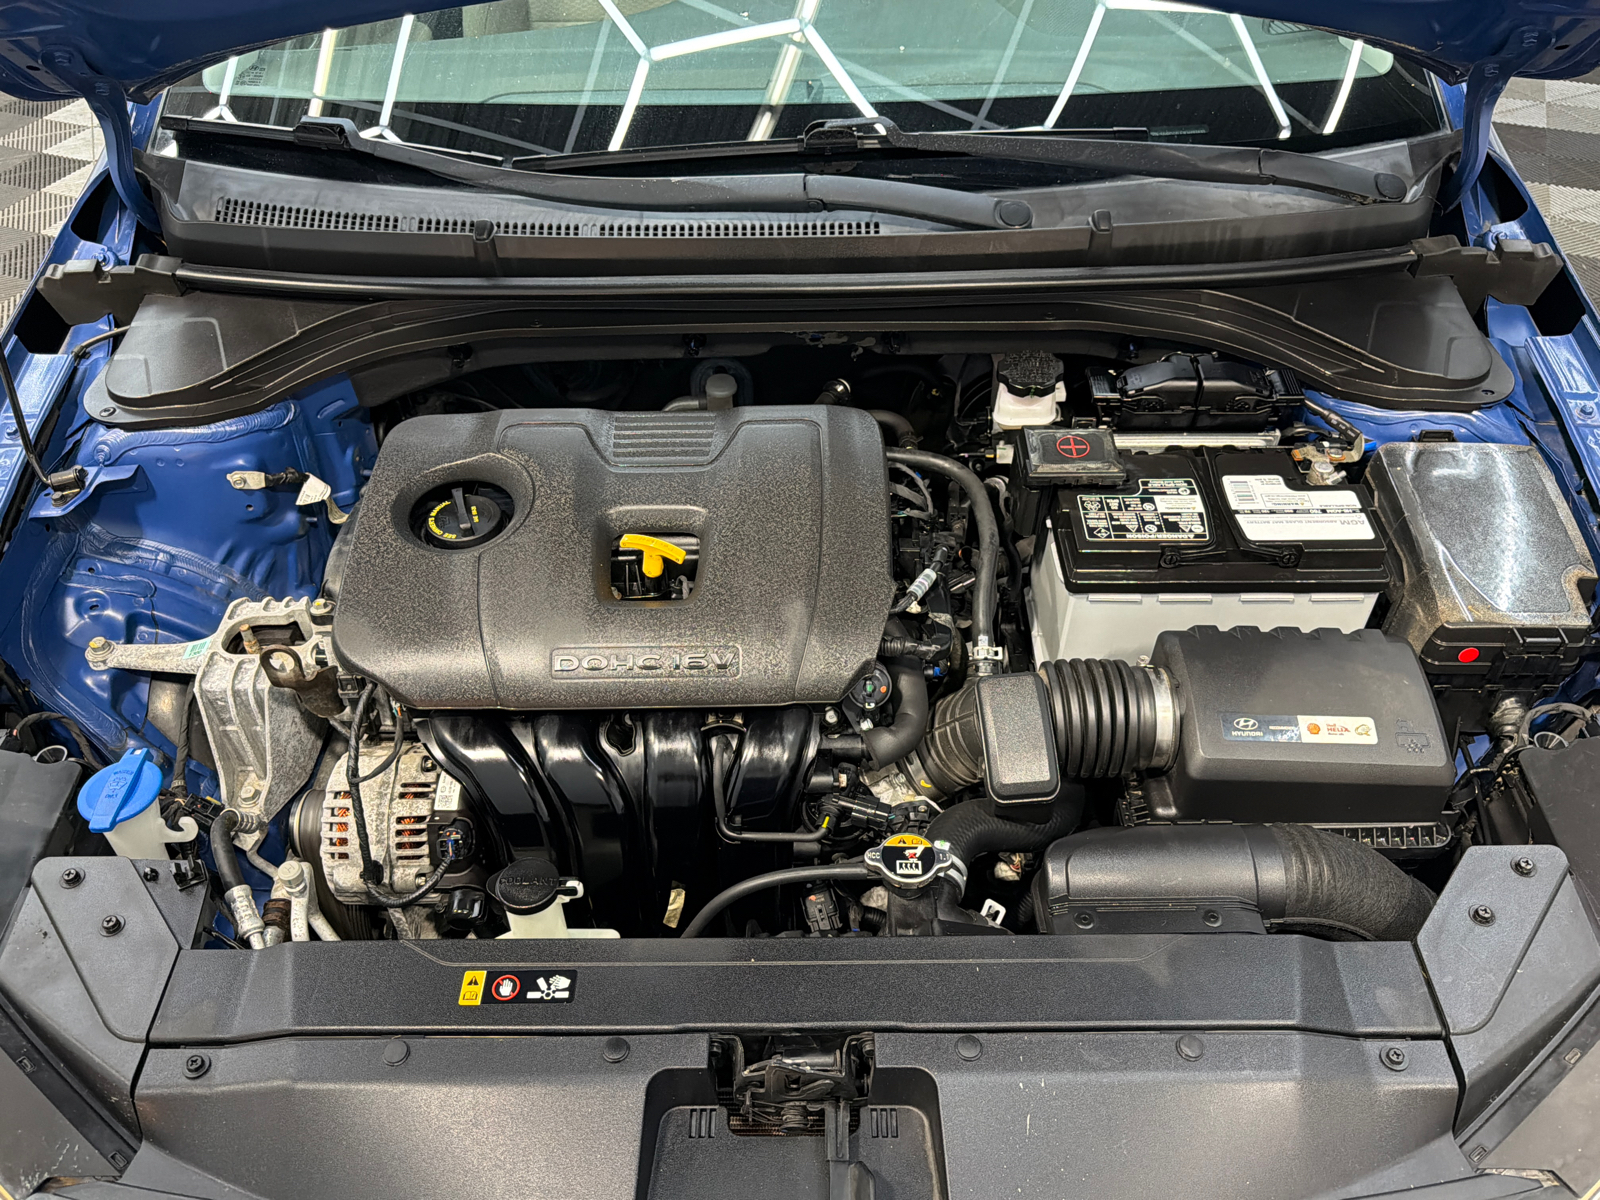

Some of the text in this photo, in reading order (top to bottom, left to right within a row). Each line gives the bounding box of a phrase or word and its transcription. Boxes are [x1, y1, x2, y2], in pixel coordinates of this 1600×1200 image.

[429, 500, 451, 517] MANUAL
[554, 653, 735, 672] DOHC 16V
[499, 877, 558, 886] COOLANT
